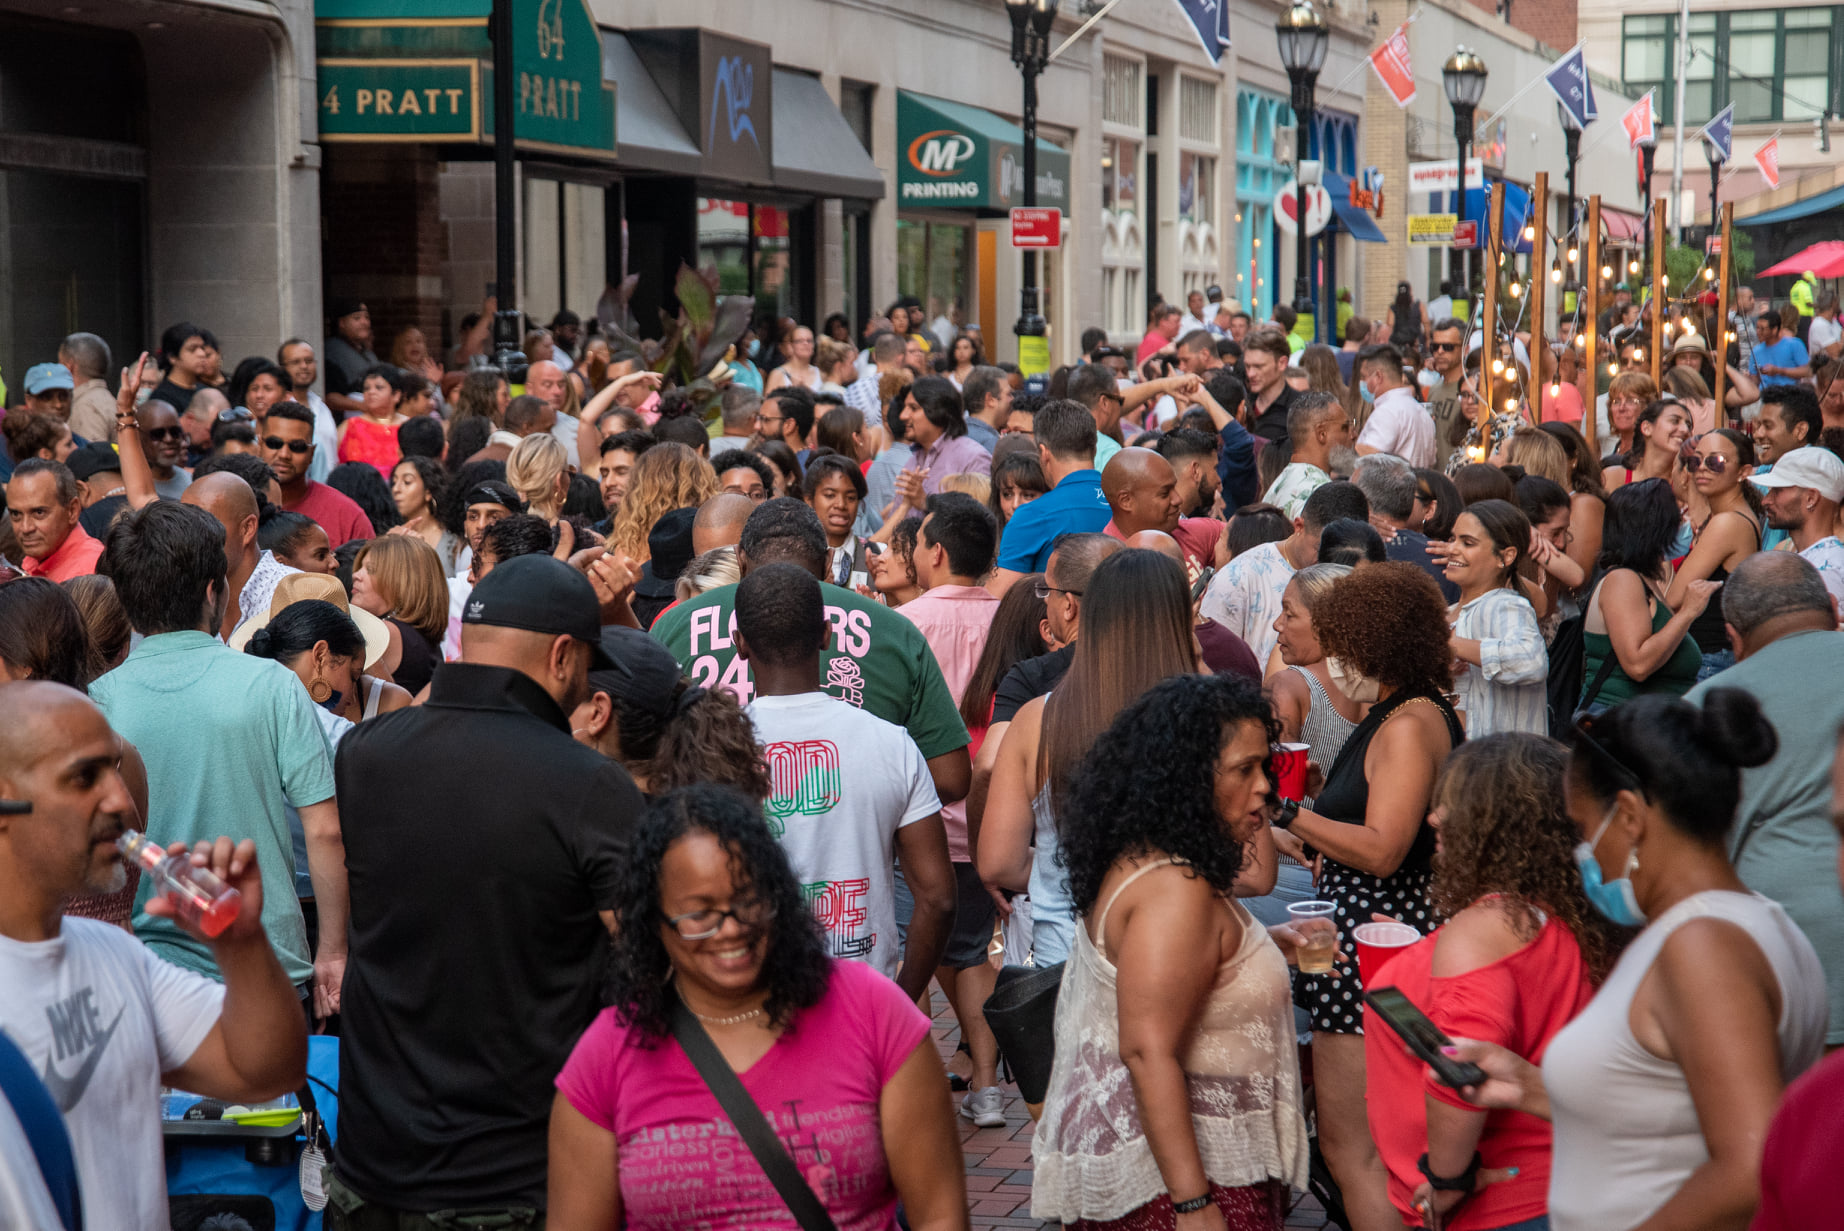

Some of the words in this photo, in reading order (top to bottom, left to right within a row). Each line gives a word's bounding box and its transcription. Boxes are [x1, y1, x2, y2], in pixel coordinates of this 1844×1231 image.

[537, 0, 566, 60] 64
[356, 88, 463, 115] PRATT
[520, 71, 581, 121] PRATT
[903, 182, 979, 198] PRINTING
[690, 604, 872, 658] FLRS
